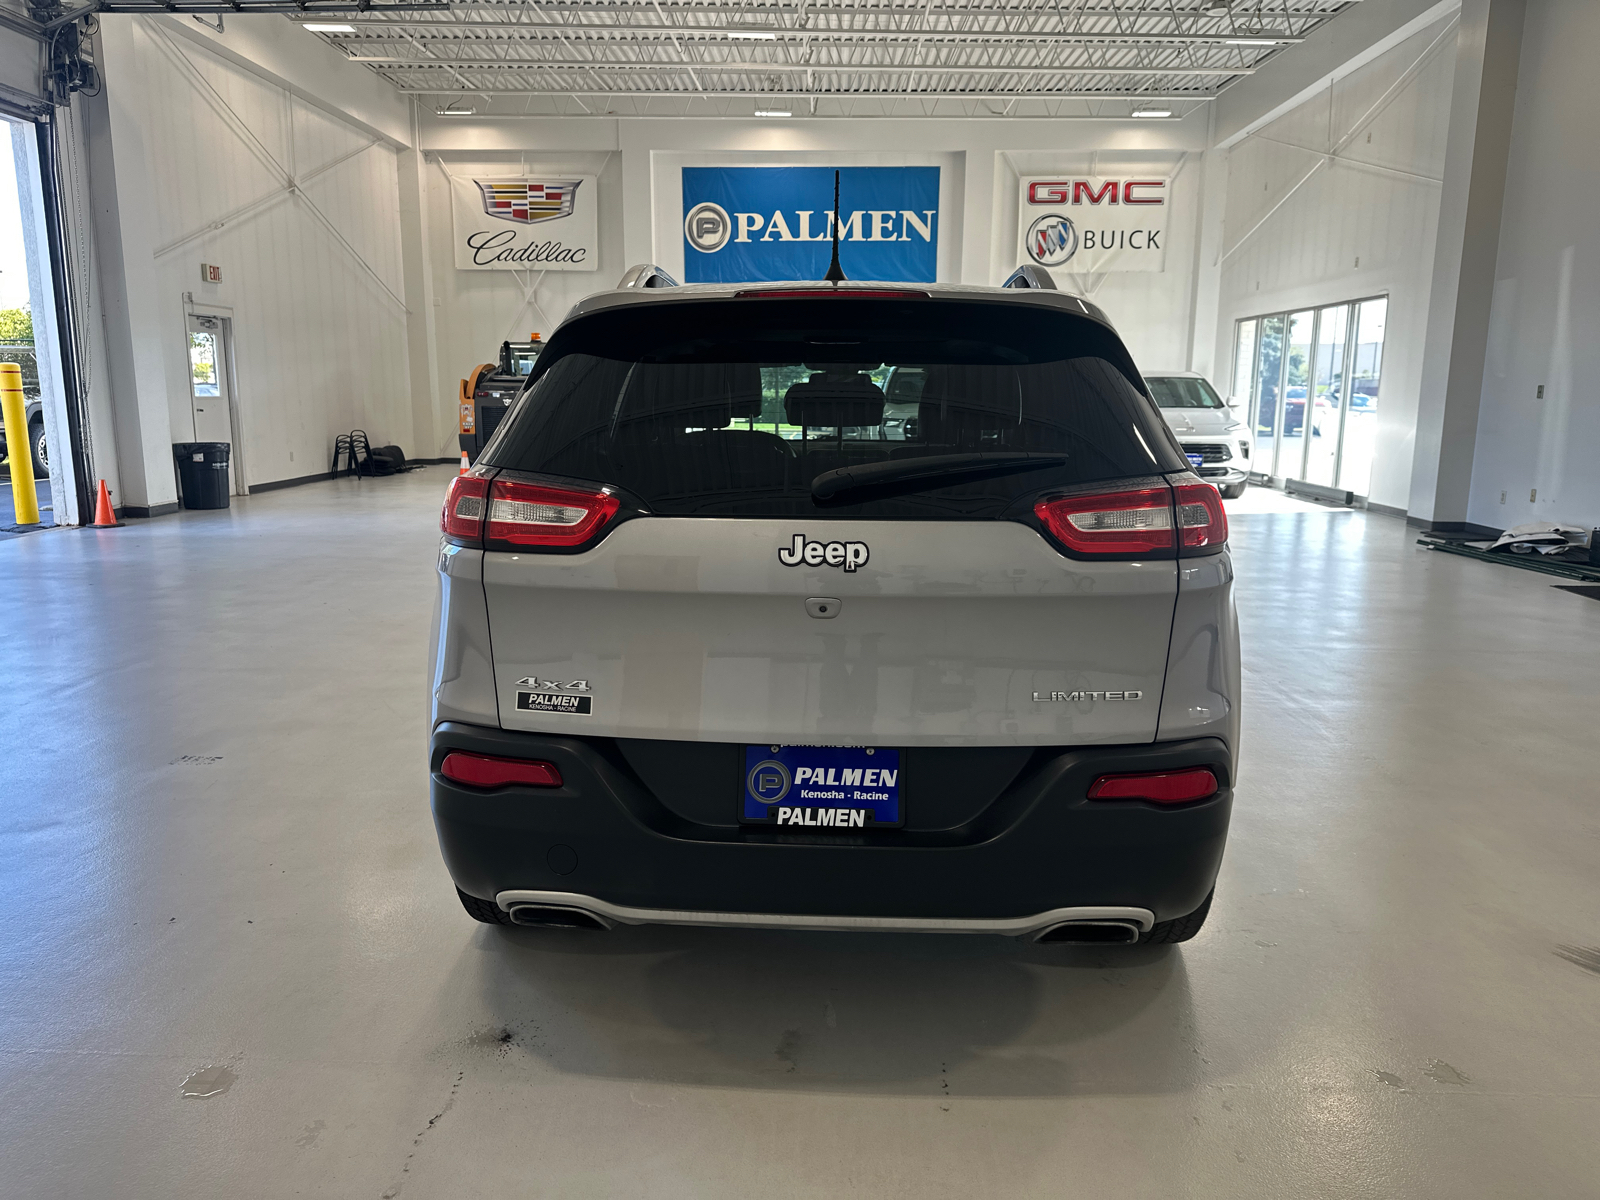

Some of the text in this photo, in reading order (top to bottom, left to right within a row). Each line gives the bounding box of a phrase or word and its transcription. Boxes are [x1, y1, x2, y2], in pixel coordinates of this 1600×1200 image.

[1027, 180, 1166, 205] GMC
[733, 210, 936, 242] PALMEN
[467, 230, 586, 265] Cadillac
[1084, 230, 1161, 250] BUICK
[209, 265, 220, 281] EXIT
[778, 534, 870, 573] Jeep
[515, 676, 592, 692] 4x4
[529, 694, 579, 707] PALMEN
[1032, 690, 1143, 702] LIMITED
[794, 767, 898, 787] PALMEN
[801, 790, 845, 799] Kenosha
[853, 791, 889, 800] Racine
[777, 807, 866, 828] PALMEN
